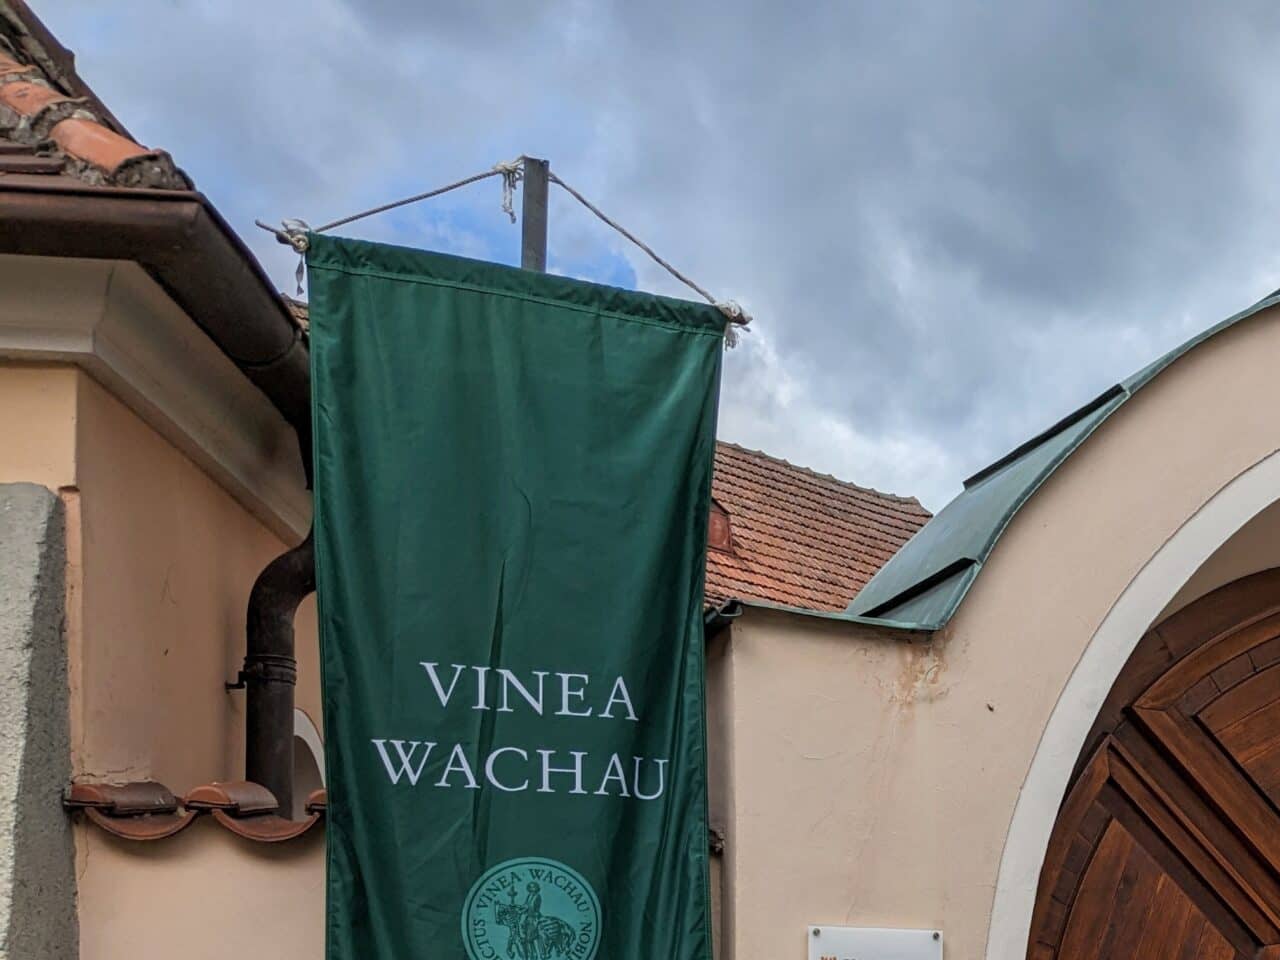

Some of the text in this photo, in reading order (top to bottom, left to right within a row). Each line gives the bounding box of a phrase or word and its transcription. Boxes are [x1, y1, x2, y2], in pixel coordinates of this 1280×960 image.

[419, 661, 640, 721] VINEA
[371, 739, 669, 800] WACHAU
[476, 871, 523, 910] VINEA
[528, 868, 590, 913] WACHAU
